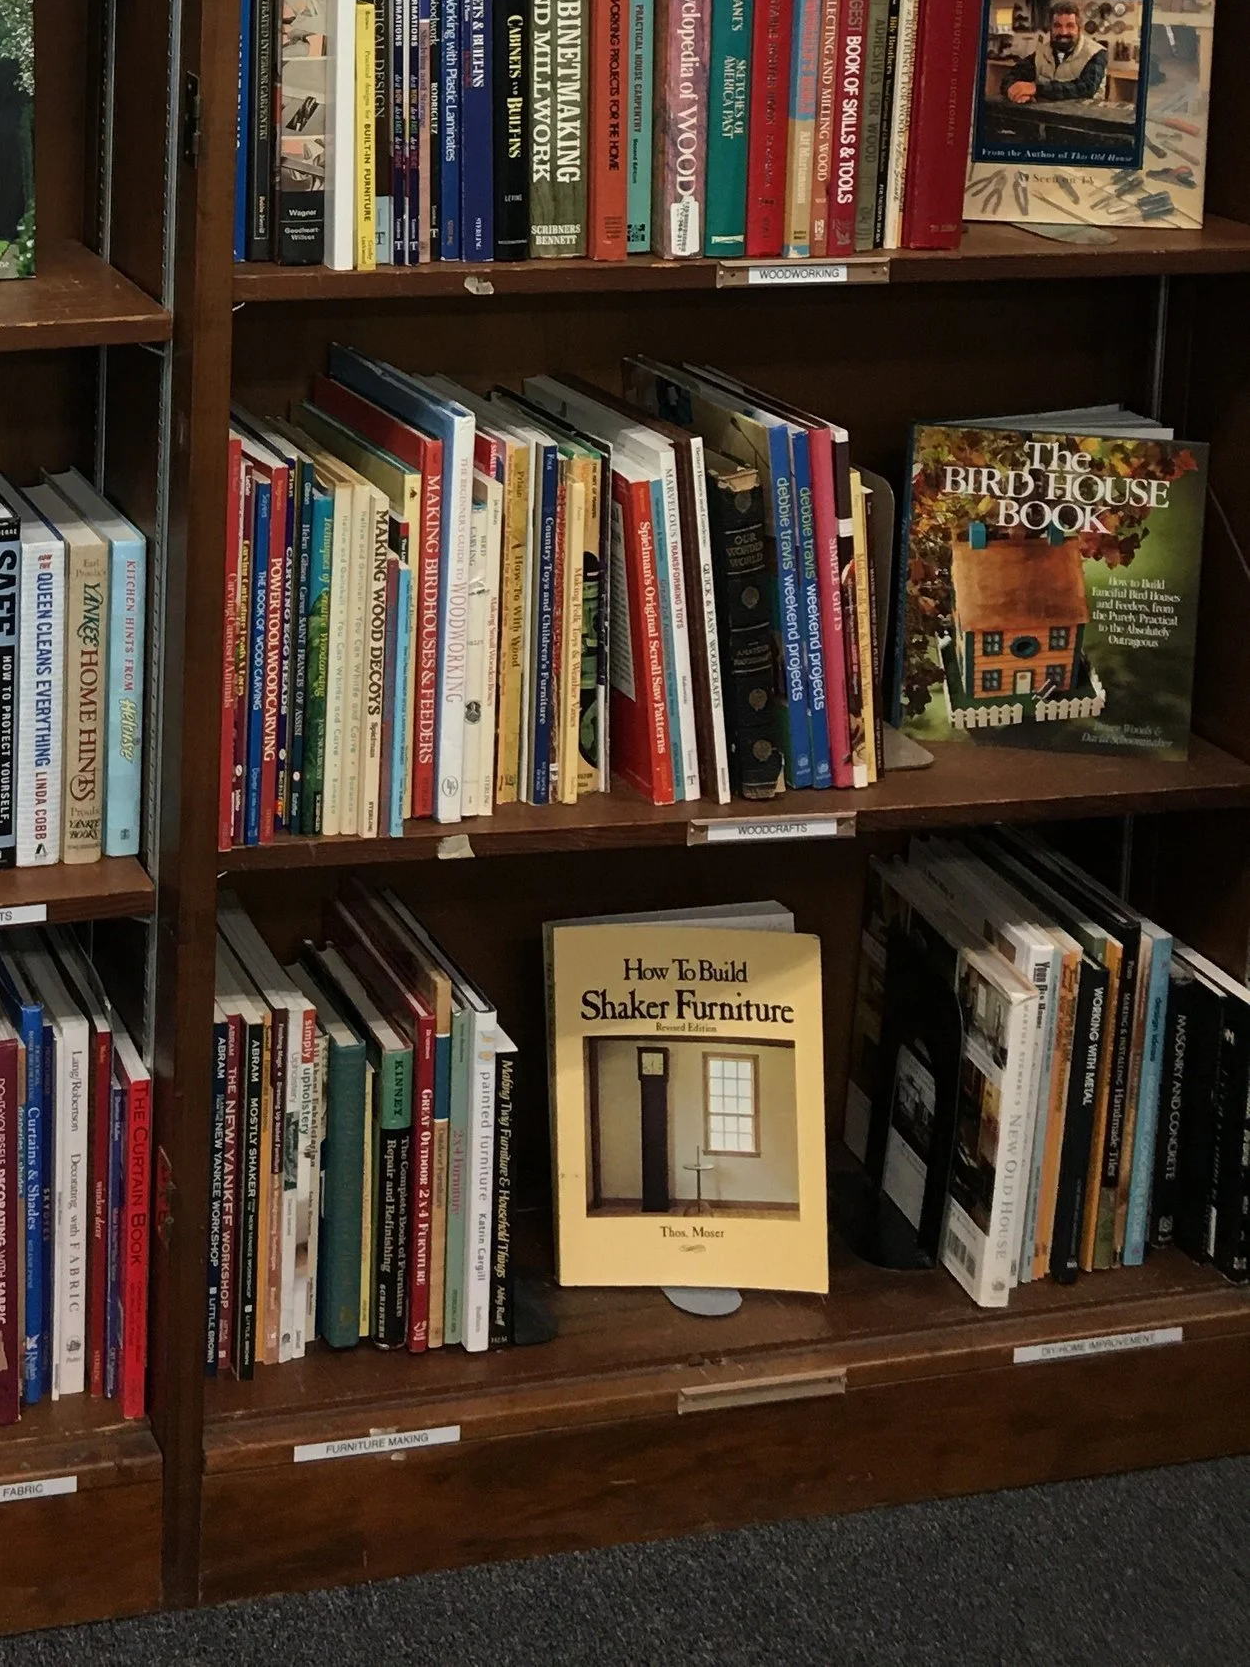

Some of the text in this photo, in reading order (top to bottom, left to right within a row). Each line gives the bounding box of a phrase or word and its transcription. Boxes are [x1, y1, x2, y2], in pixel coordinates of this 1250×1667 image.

[532, 31, 552, 184] MILLWORK
[531, 224, 581, 236] SCRIBNERS
[535, 236, 577, 245] BENNETT
[759, 269, 840, 280] WOODWORKING
[1024, 441, 1092, 473] The
[942, 466, 1171, 508] BIRD HOUSE
[425, 474, 440, 553] MAKING
[997, 500, 1112, 534] BOOK
[421, 556, 439, 665] BIRDHOUSES
[419, 682, 434, 765] FEEDERS
[737, 823, 808, 835] WOODCRAFTS
[623, 958, 749, 983] How To Build
[580, 988, 795, 1024] Shaker Furniture
[655, 1022, 717, 1033] Revised Edition
[1082, 986, 1104, 1106] WORKING WITH METAL
[394, 1060, 404, 1117] KINNEY
[131, 1081, 149, 1266] THE CURTAIN BOOK
[659, 1225, 725, 1238] Thos. Moser
[326, 1432, 429, 1454] FURNITURE MAKING
[2, 1483, 44, 1498] FABRIC
